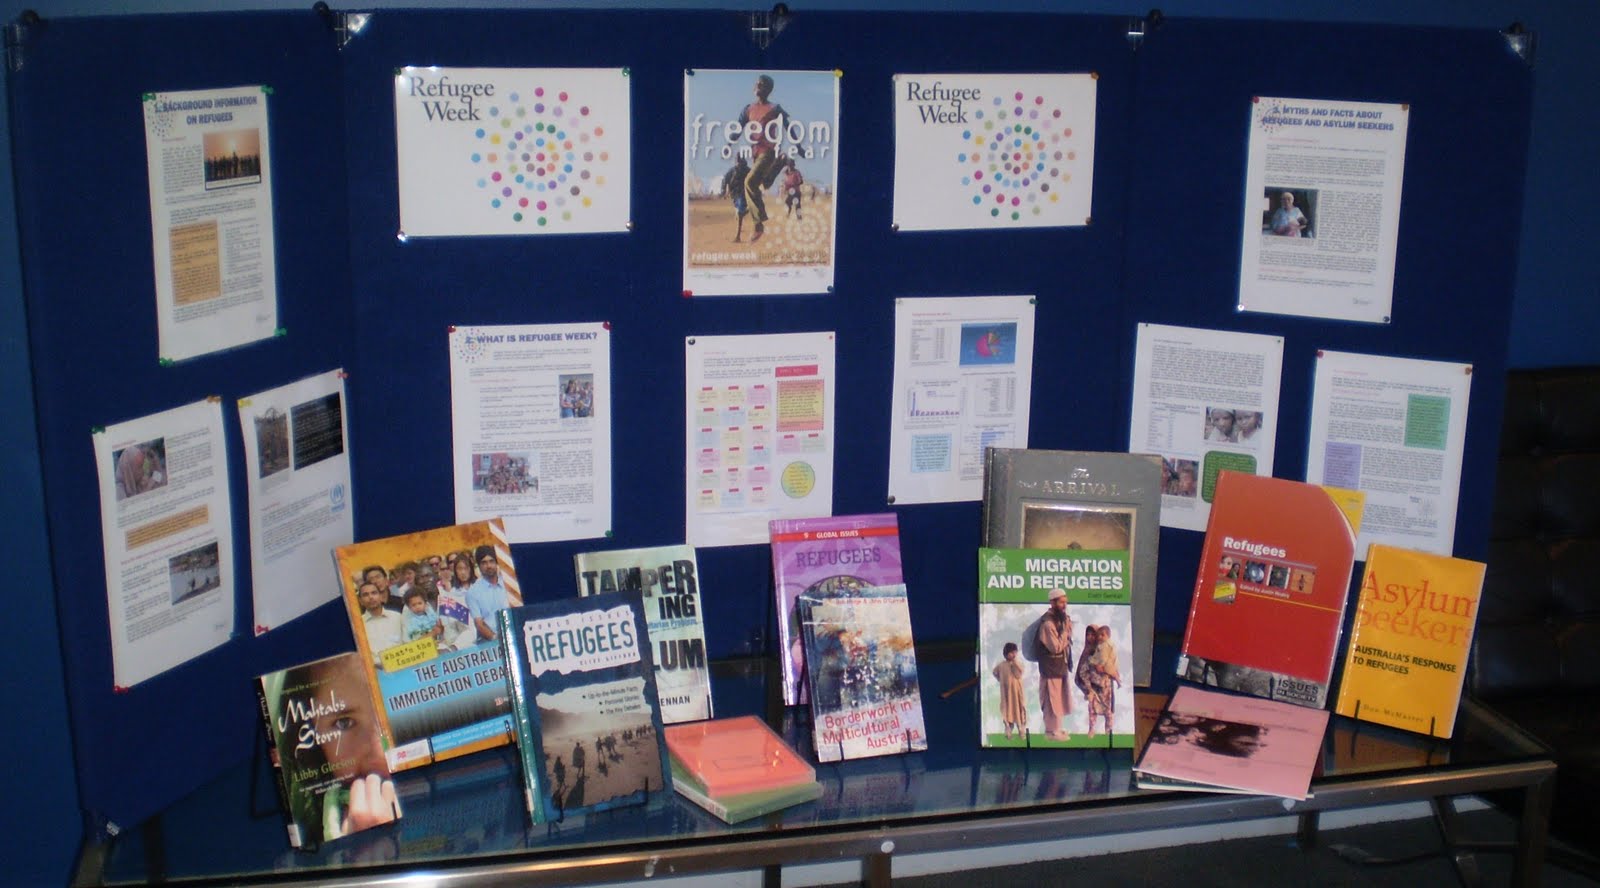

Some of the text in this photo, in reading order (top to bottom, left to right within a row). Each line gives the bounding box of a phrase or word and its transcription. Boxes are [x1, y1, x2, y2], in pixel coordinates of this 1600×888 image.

[410, 76, 495, 103] Refugee
[907, 82, 981, 107] Refugee
[164, 98, 213, 112] BACKGROUND
[214, 96, 258, 108] INFORMATION
[423, 98, 481, 121] Week
[918, 103, 969, 124] Week
[1283, 106, 1310, 115] MYTHS
[1311, 108, 1329, 116] AND
[1330, 109, 1354, 118] FACTS
[1355, 110, 1383, 119] ABOUT
[187, 112, 233, 125] ON REFUGEES
[692, 113, 832, 144] freedom
[1263, 115, 1394, 131] REFUGEES AND ASYLUM SEEKERS
[691, 143, 830, 159] from fear
[477, 335, 504, 344] WHAT
[507, 334, 516, 343] IS
[519, 333, 563, 342] REFUGEE
[564, 332, 598, 341] WEEK?
[1070, 467, 1090, 480] The
[1042, 480, 1121, 497] ARRIVAL
[816, 531, 838, 539] GLOBAL
[840, 530, 859, 538] ISSUES
[795, 547, 882, 568] REFUGEES
[1223, 536, 1287, 558] Refugees
[1026, 558, 1123, 573] MIGRATION
[582, 560, 697, 598] TAMPER
[986, 575, 1124, 590] AND REFUGEES
[658, 594, 697, 620] ING
[528, 610, 630, 631] WORLD ISSUES
[384, 641, 432, 661] What's the
[531, 620, 635, 663] REFUGEES
[396, 652, 425, 666] Issue?
[652, 638, 705, 671] UM
[1353, 655, 1409, 675] TO REFUGEES
[1355, 645, 1457, 673] AUSTRALIA'S RESPONSE
[414, 664, 439, 682] THE
[389, 675, 473, 711] IMMIGRATION
[1278, 677, 1319, 695] ISSUES
[825, 698, 912, 729] Borderwork in
[294, 724, 342, 758] Story
[823, 716, 901, 745] Multicultural
[867, 726, 921, 750] Australia
[294, 767, 319, 783] Libby
[321, 757, 356, 775] Gleeson
